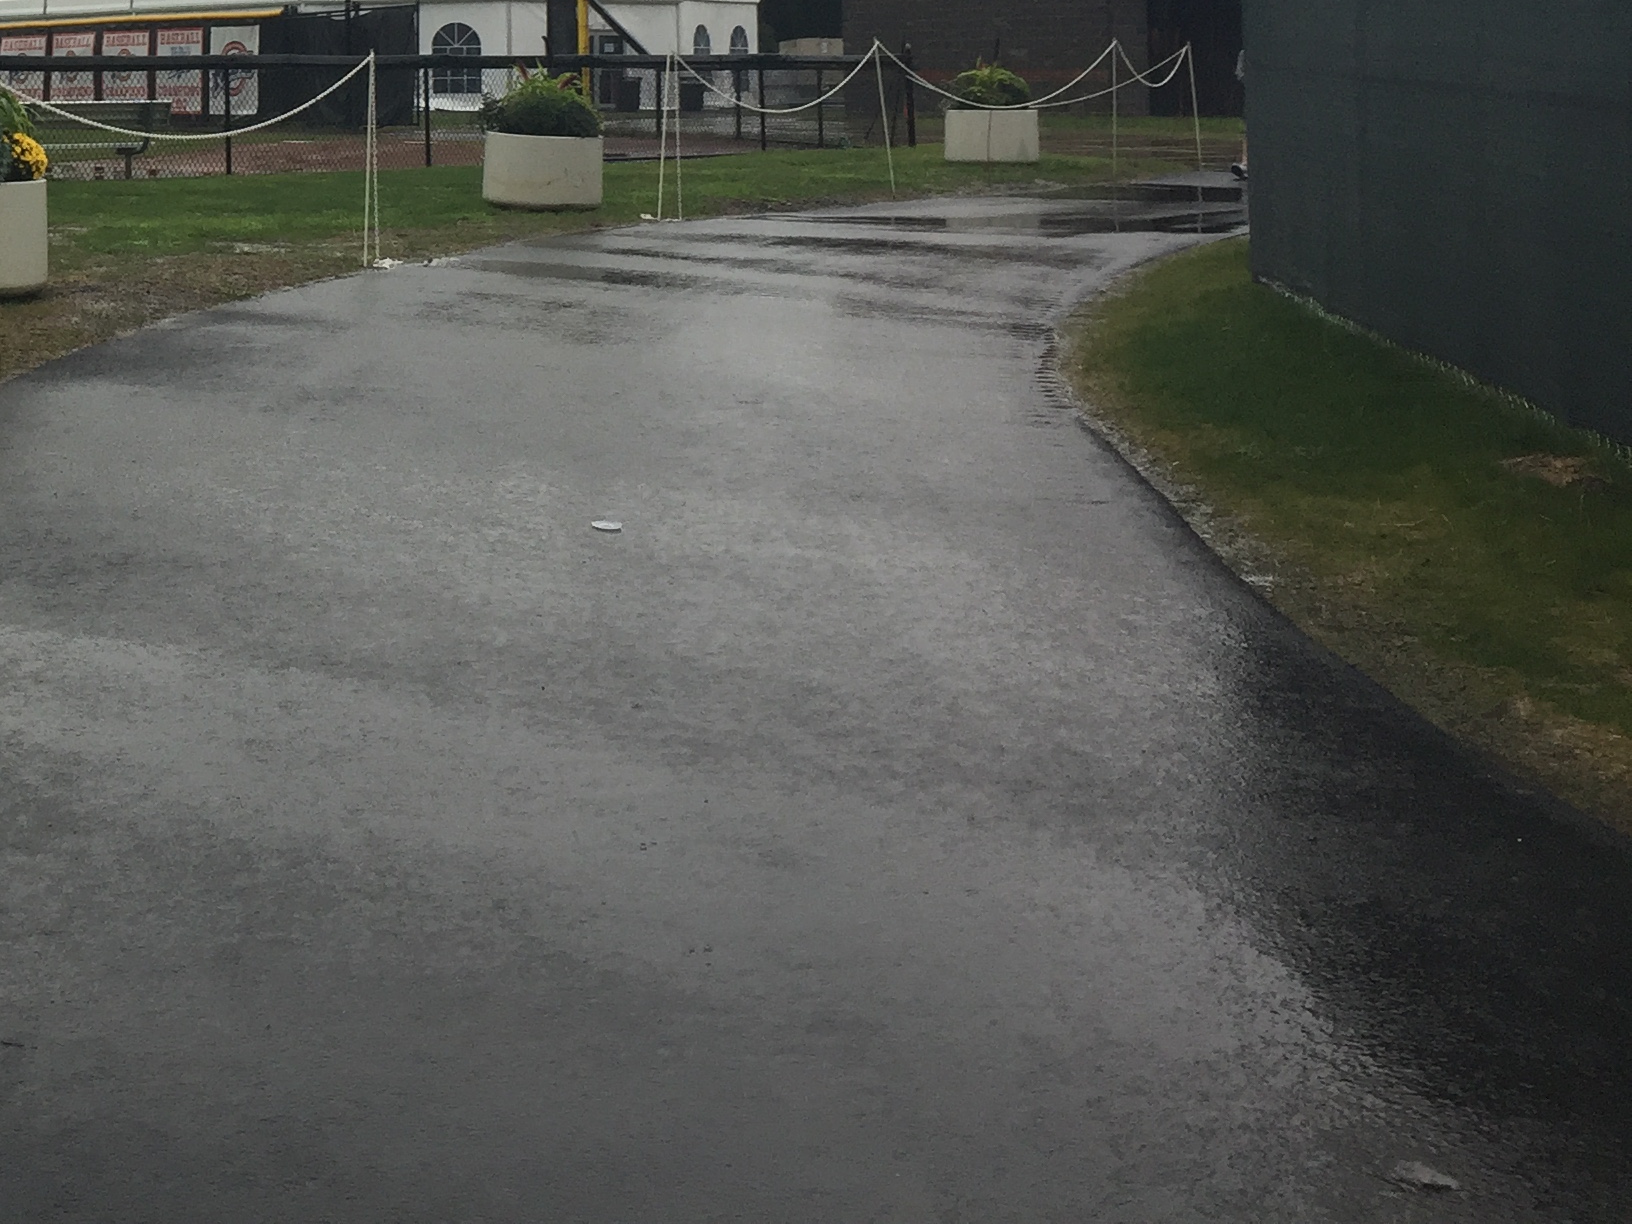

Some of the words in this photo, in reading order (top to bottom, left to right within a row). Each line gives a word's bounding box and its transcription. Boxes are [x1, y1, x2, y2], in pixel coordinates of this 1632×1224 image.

[3, 38, 43, 51] BASEBALL
[55, 36, 91, 49] BASEBALL
[105, 33, 147, 47] BASEBALL
[160, 31, 200, 45] BASEBALL
